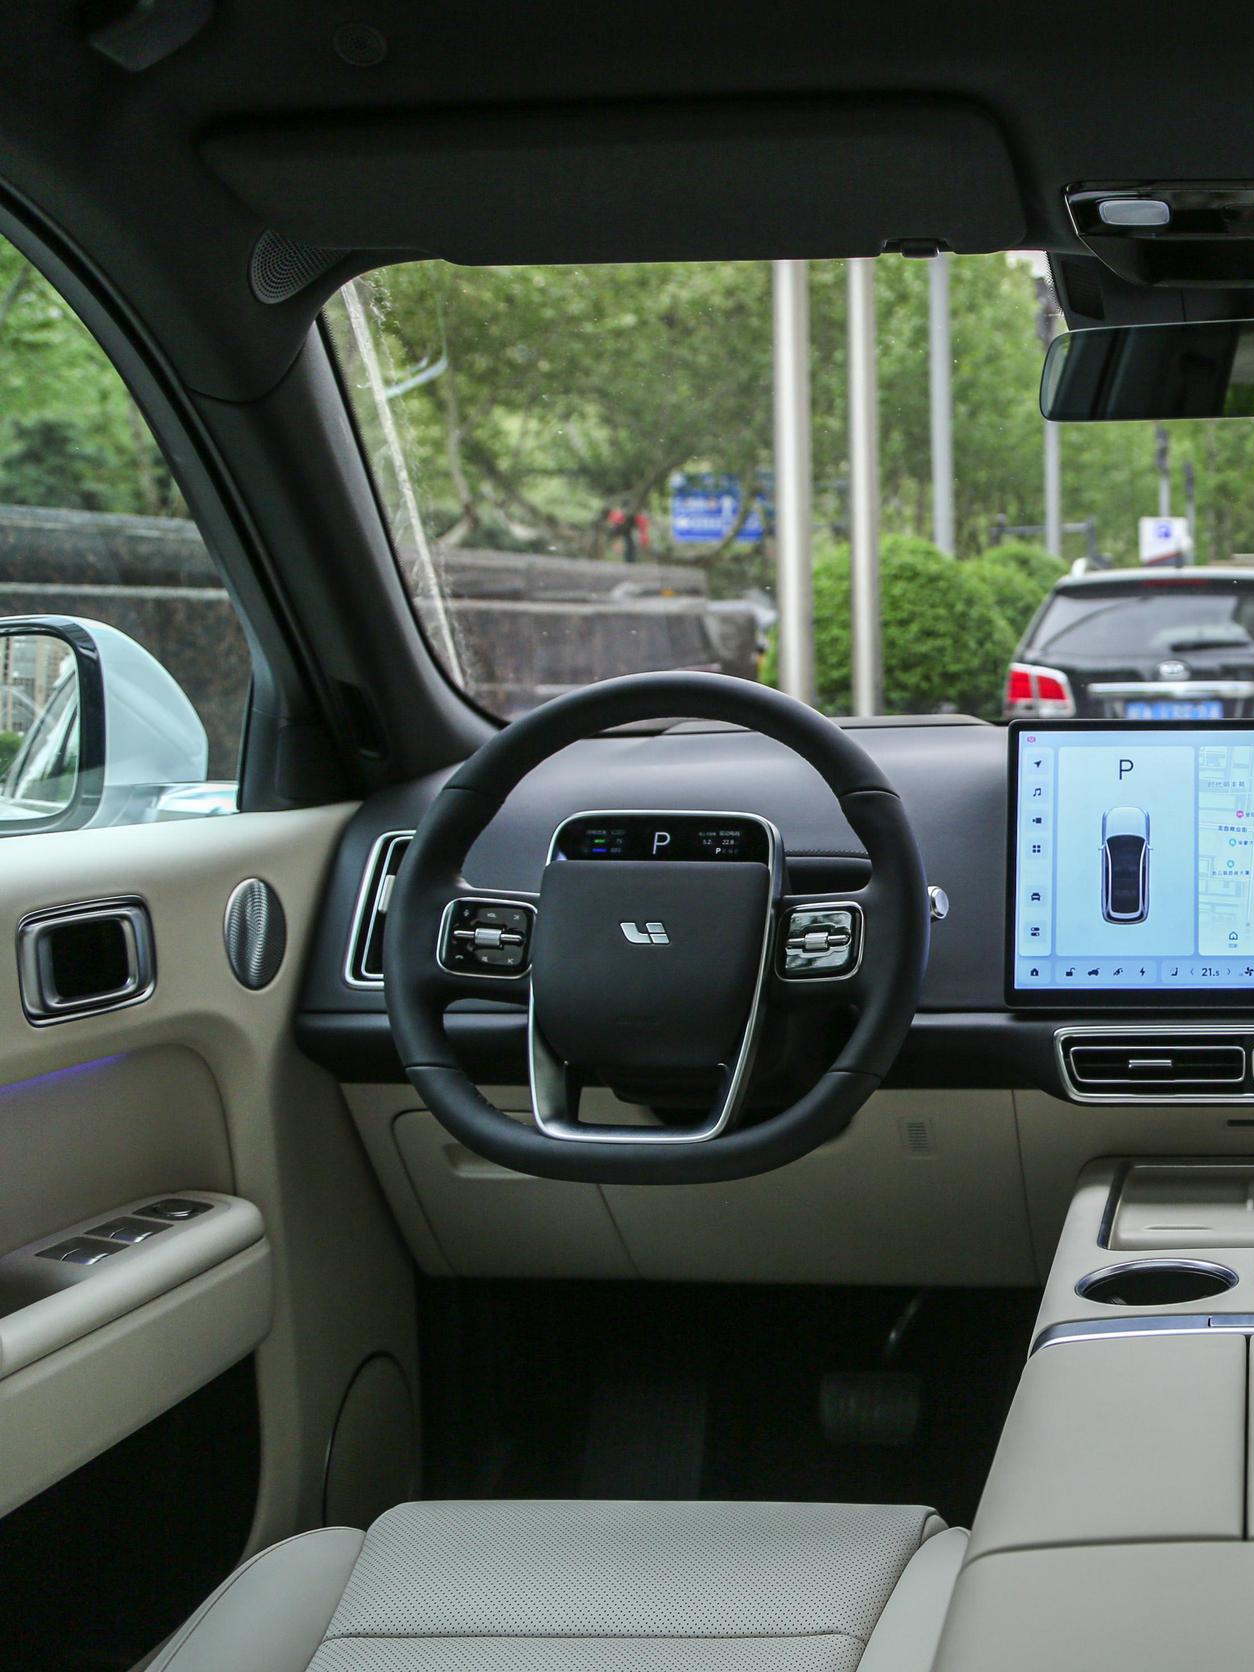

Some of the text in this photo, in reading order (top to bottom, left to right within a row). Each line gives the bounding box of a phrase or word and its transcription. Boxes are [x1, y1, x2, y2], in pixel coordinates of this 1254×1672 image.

[1118, 759, 1134, 780] P
[652, 831, 671, 855] P
[1201, 966, 1220, 977] 21.5
